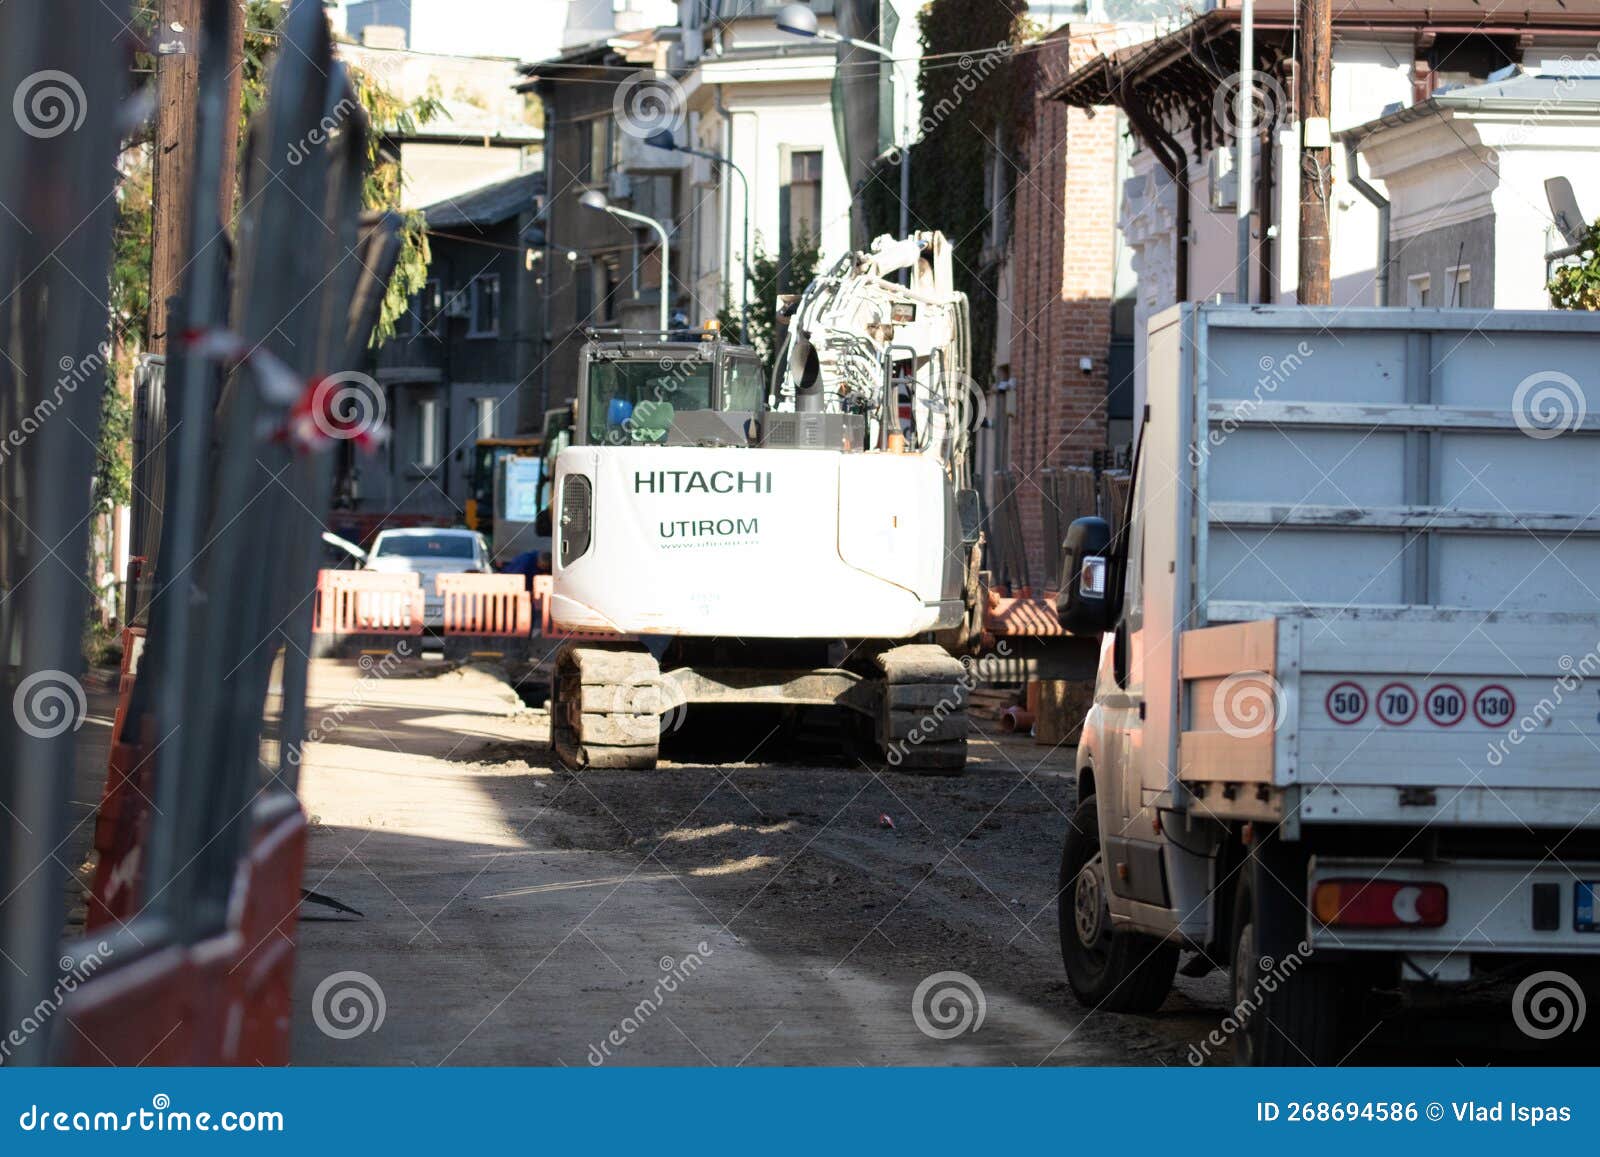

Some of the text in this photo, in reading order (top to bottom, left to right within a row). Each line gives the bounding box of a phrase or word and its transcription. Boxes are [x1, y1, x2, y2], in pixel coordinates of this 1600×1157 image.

[634, 470, 772, 494] HITACHI
[659, 518, 758, 538] UTIROM
[1334, 692, 1510, 716] 50 70 90 130
